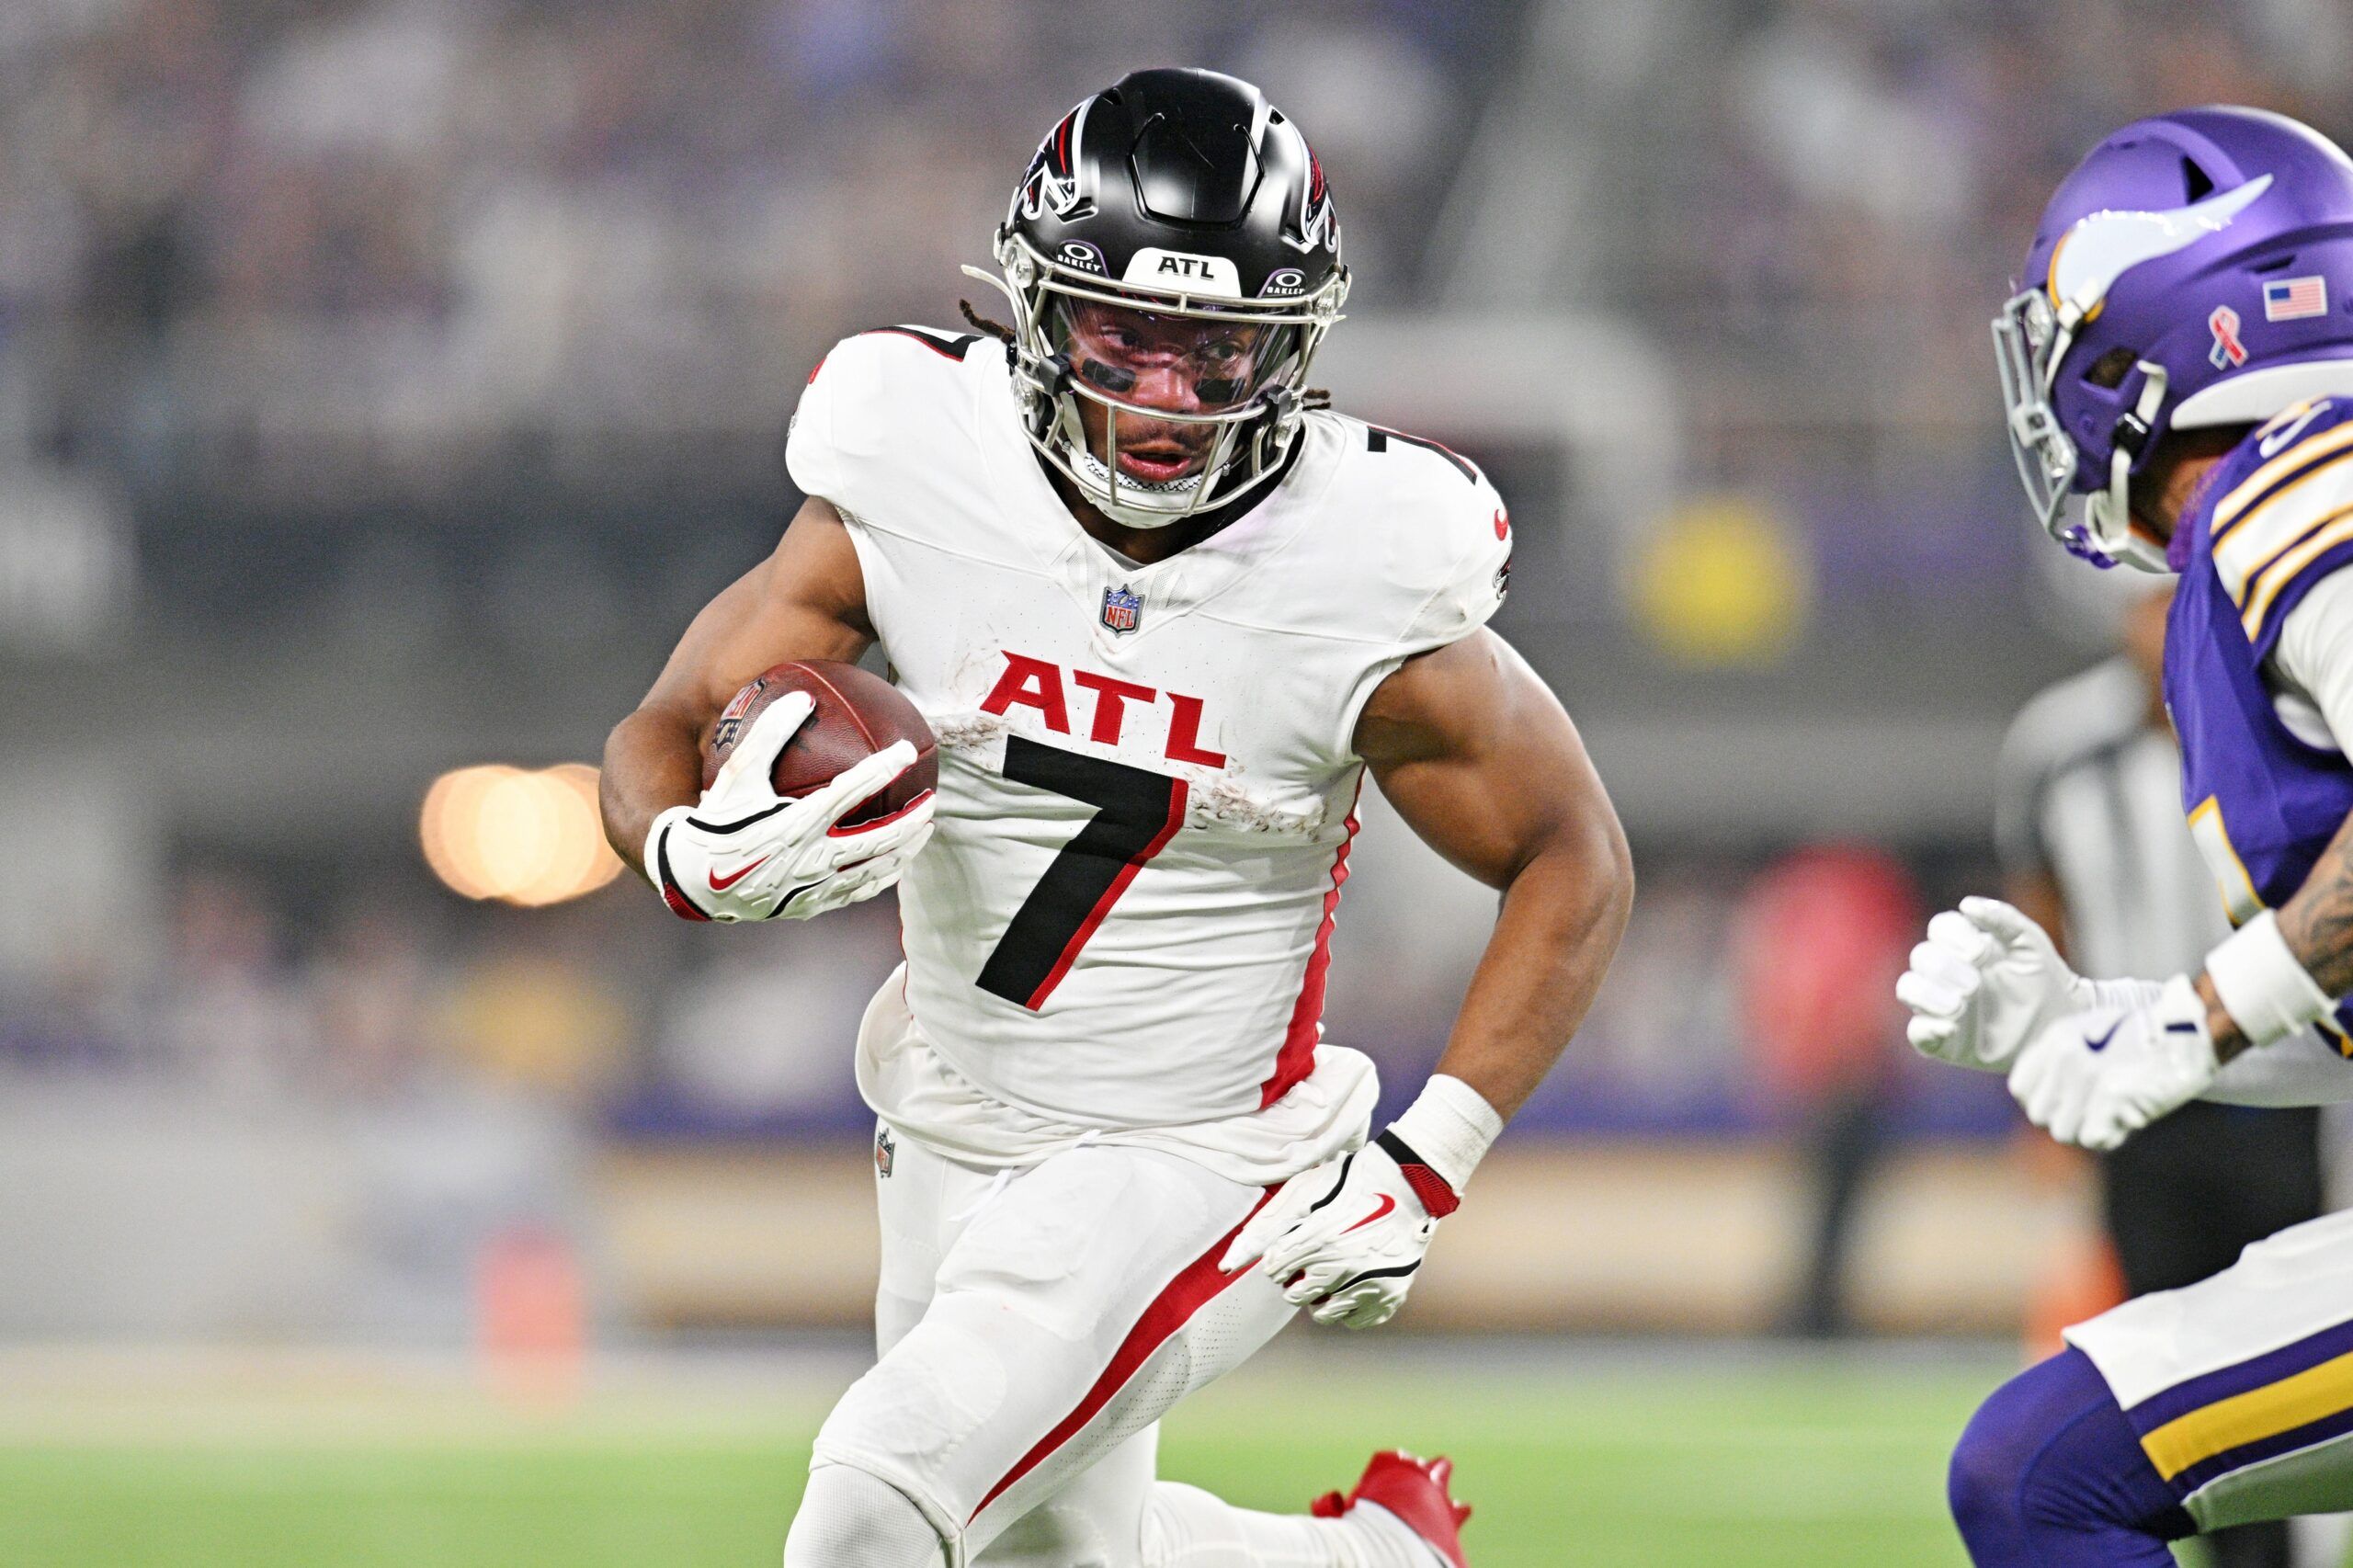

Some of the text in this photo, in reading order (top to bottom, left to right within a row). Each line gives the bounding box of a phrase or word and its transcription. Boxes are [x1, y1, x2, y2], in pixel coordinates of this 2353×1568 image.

[1057, 254, 1102, 272] OAKLEY
[1157, 256, 1215, 279] ATL
[1267, 286, 1306, 295] OAKLEY
[1105, 606, 1134, 629] NFL
[979, 649, 1227, 770] ATL
[975, 733, 1189, 1013] 7
